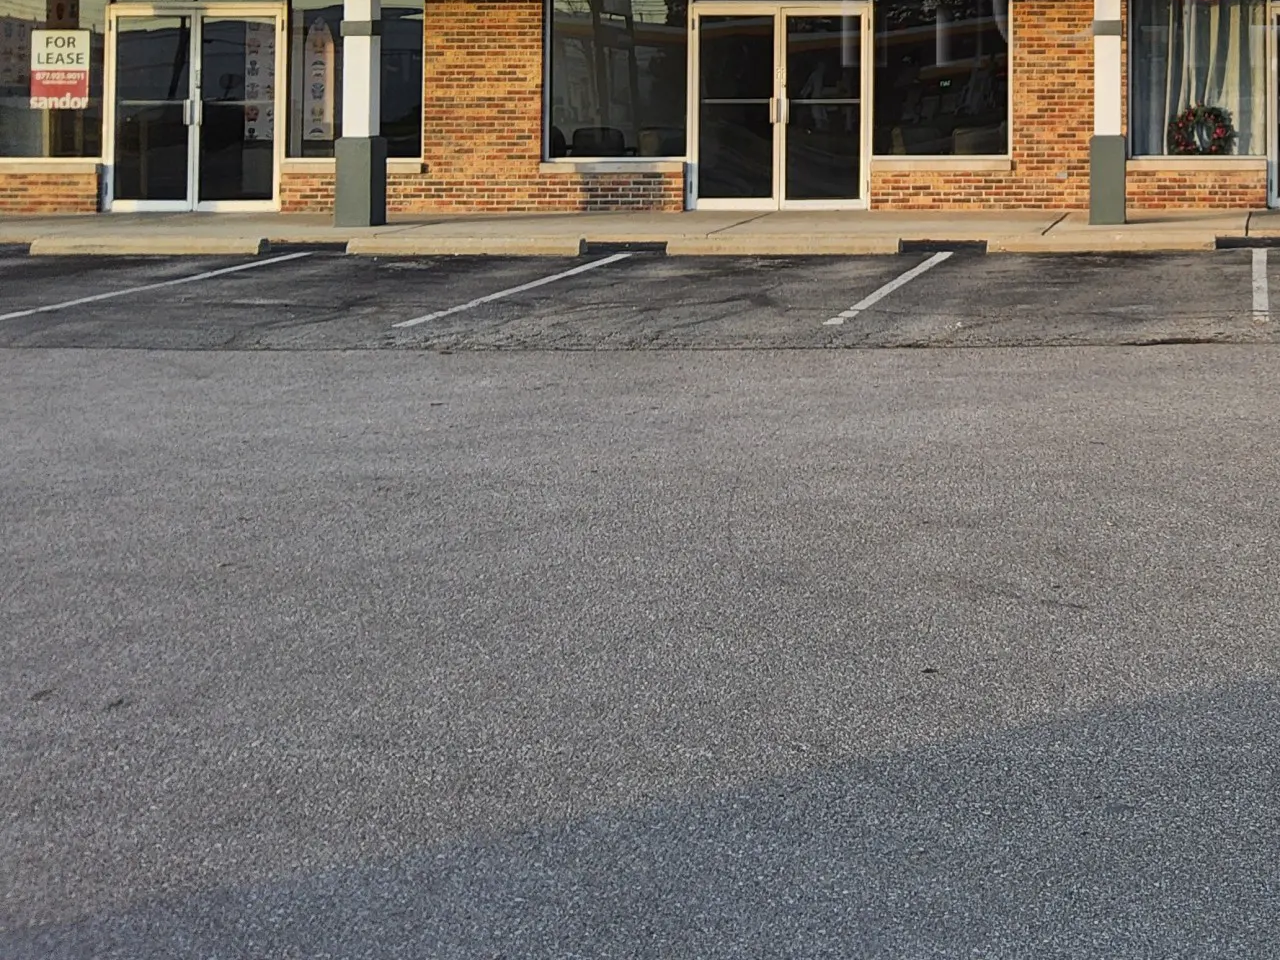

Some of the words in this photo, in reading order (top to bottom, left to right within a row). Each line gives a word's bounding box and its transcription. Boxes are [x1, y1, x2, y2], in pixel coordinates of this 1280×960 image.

[46, 36, 76, 49] FOR
[37, 52, 85, 65] LEASE
[29, 91, 88, 110] sandor
